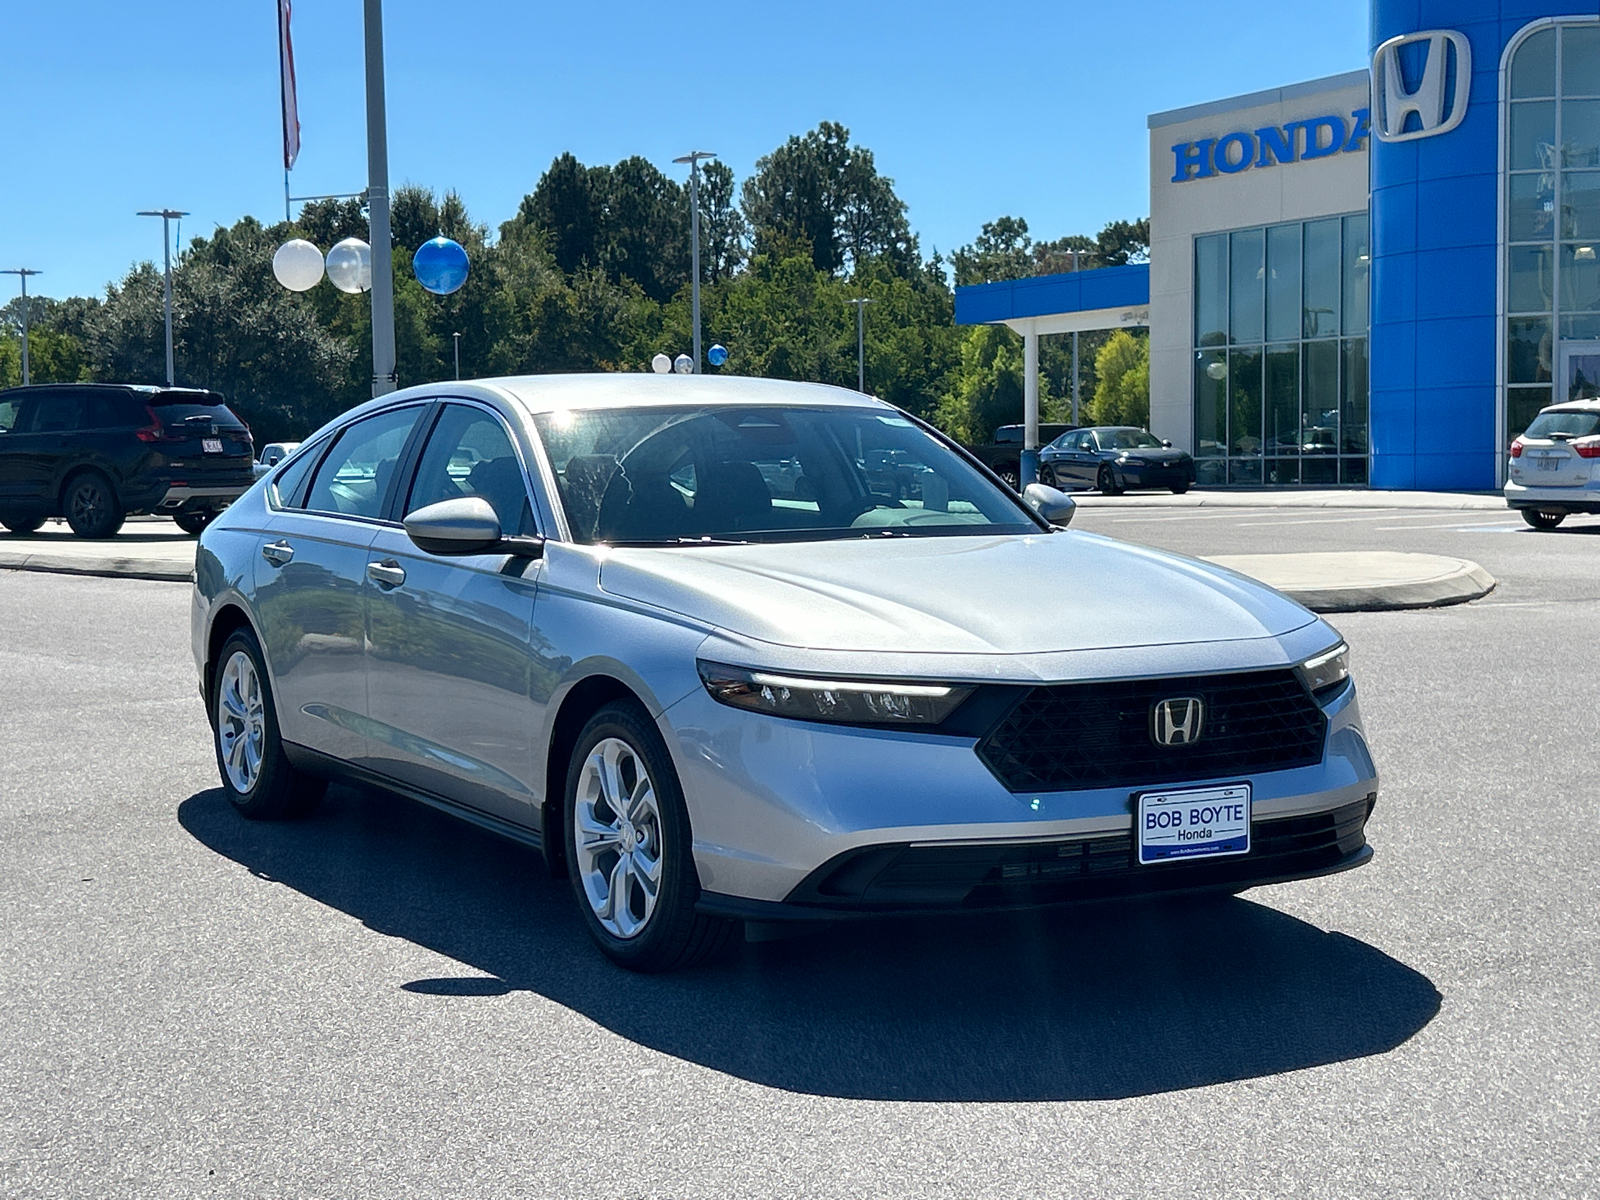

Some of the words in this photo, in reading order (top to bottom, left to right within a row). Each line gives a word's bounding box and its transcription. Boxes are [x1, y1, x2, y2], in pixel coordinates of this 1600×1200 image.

[1146, 811, 1182, 830] BOB
[1190, 804, 1243, 825] BOYTE
[1178, 828, 1212, 841] Honda
